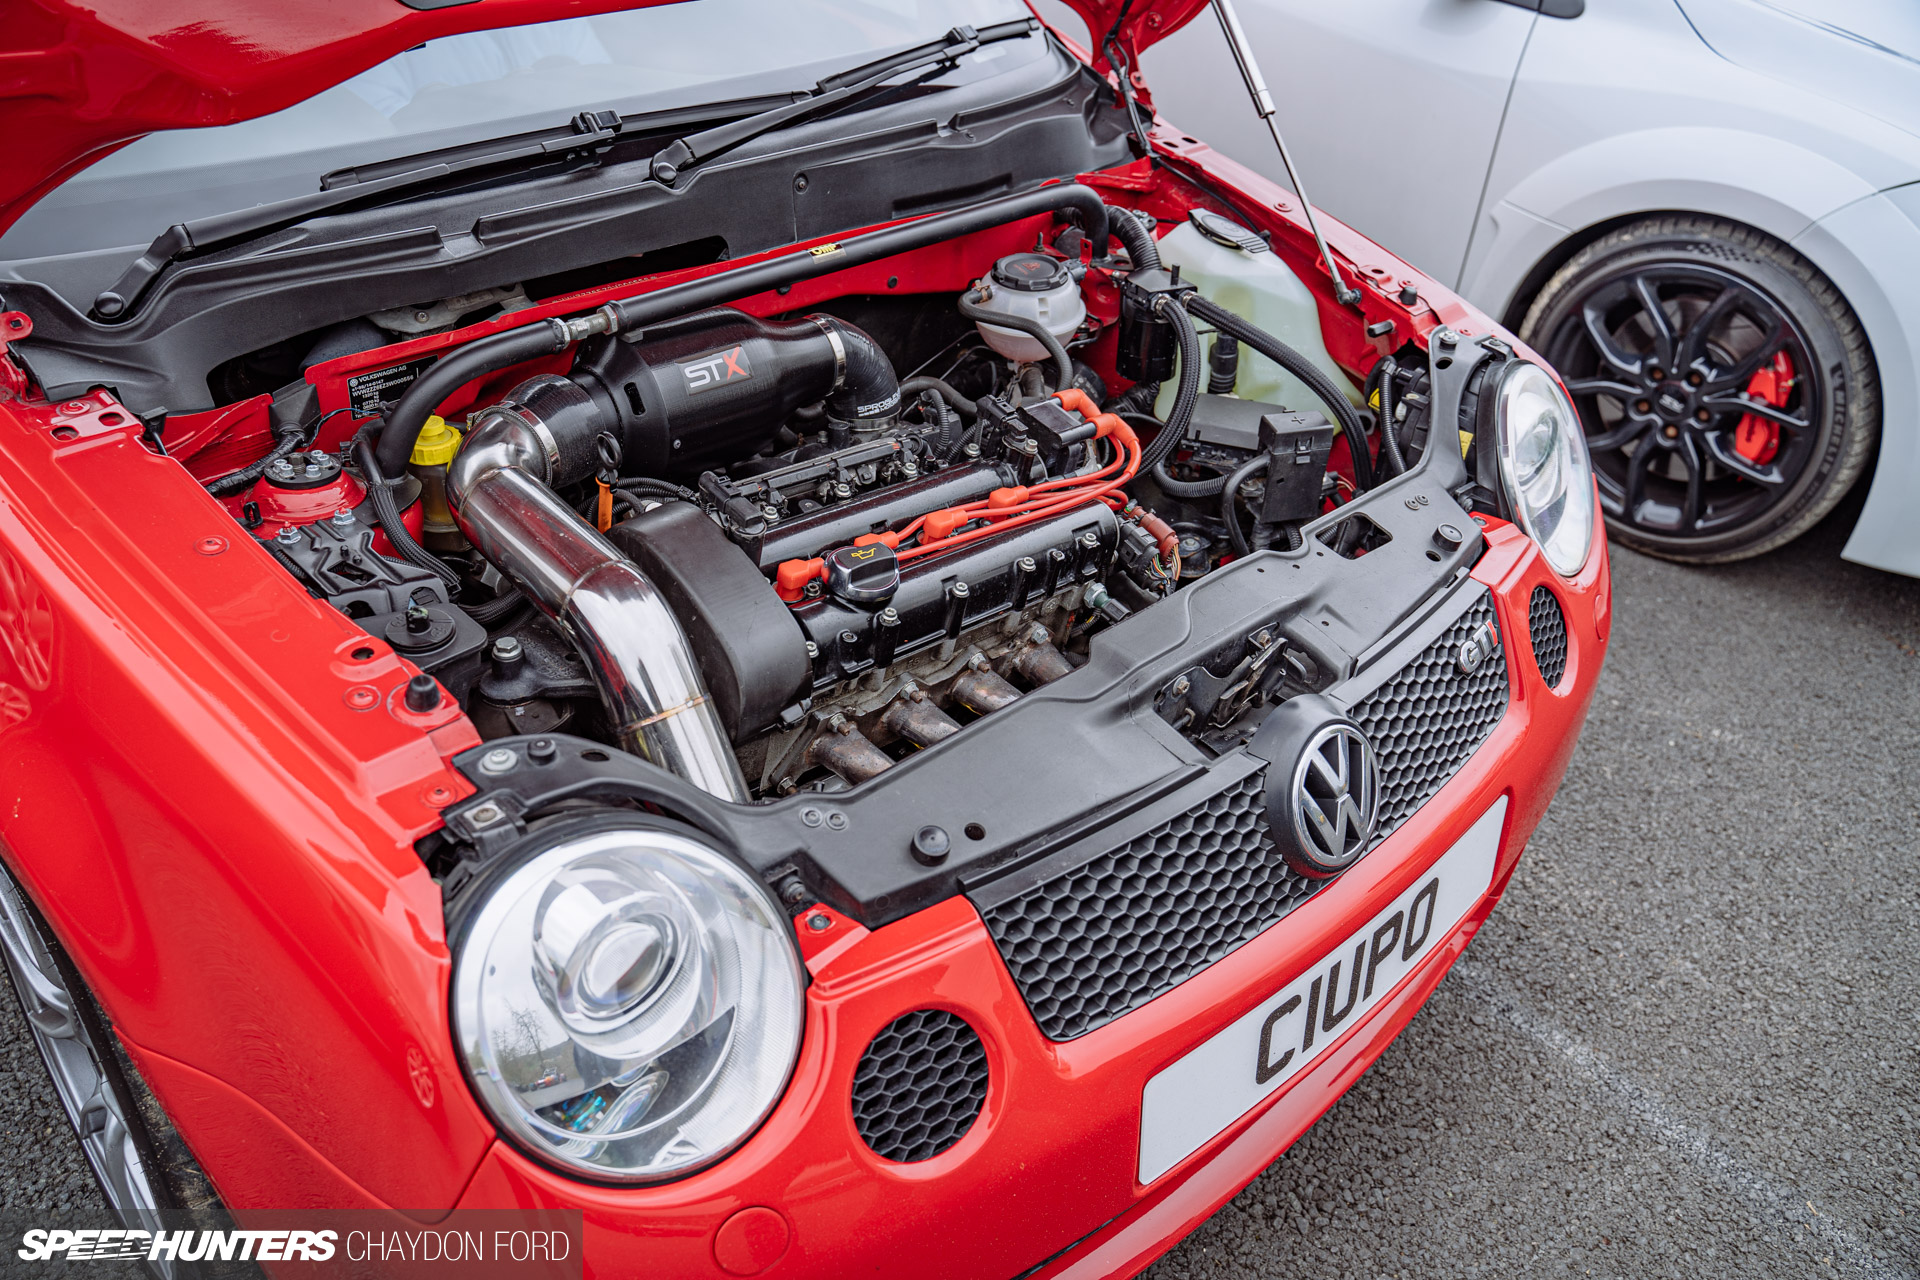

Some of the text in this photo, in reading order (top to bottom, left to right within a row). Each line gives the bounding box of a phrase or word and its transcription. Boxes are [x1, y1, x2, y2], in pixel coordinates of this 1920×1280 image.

[358, 365, 407, 383] VOLKSWAGEN AG
[684, 346, 748, 388] STX
